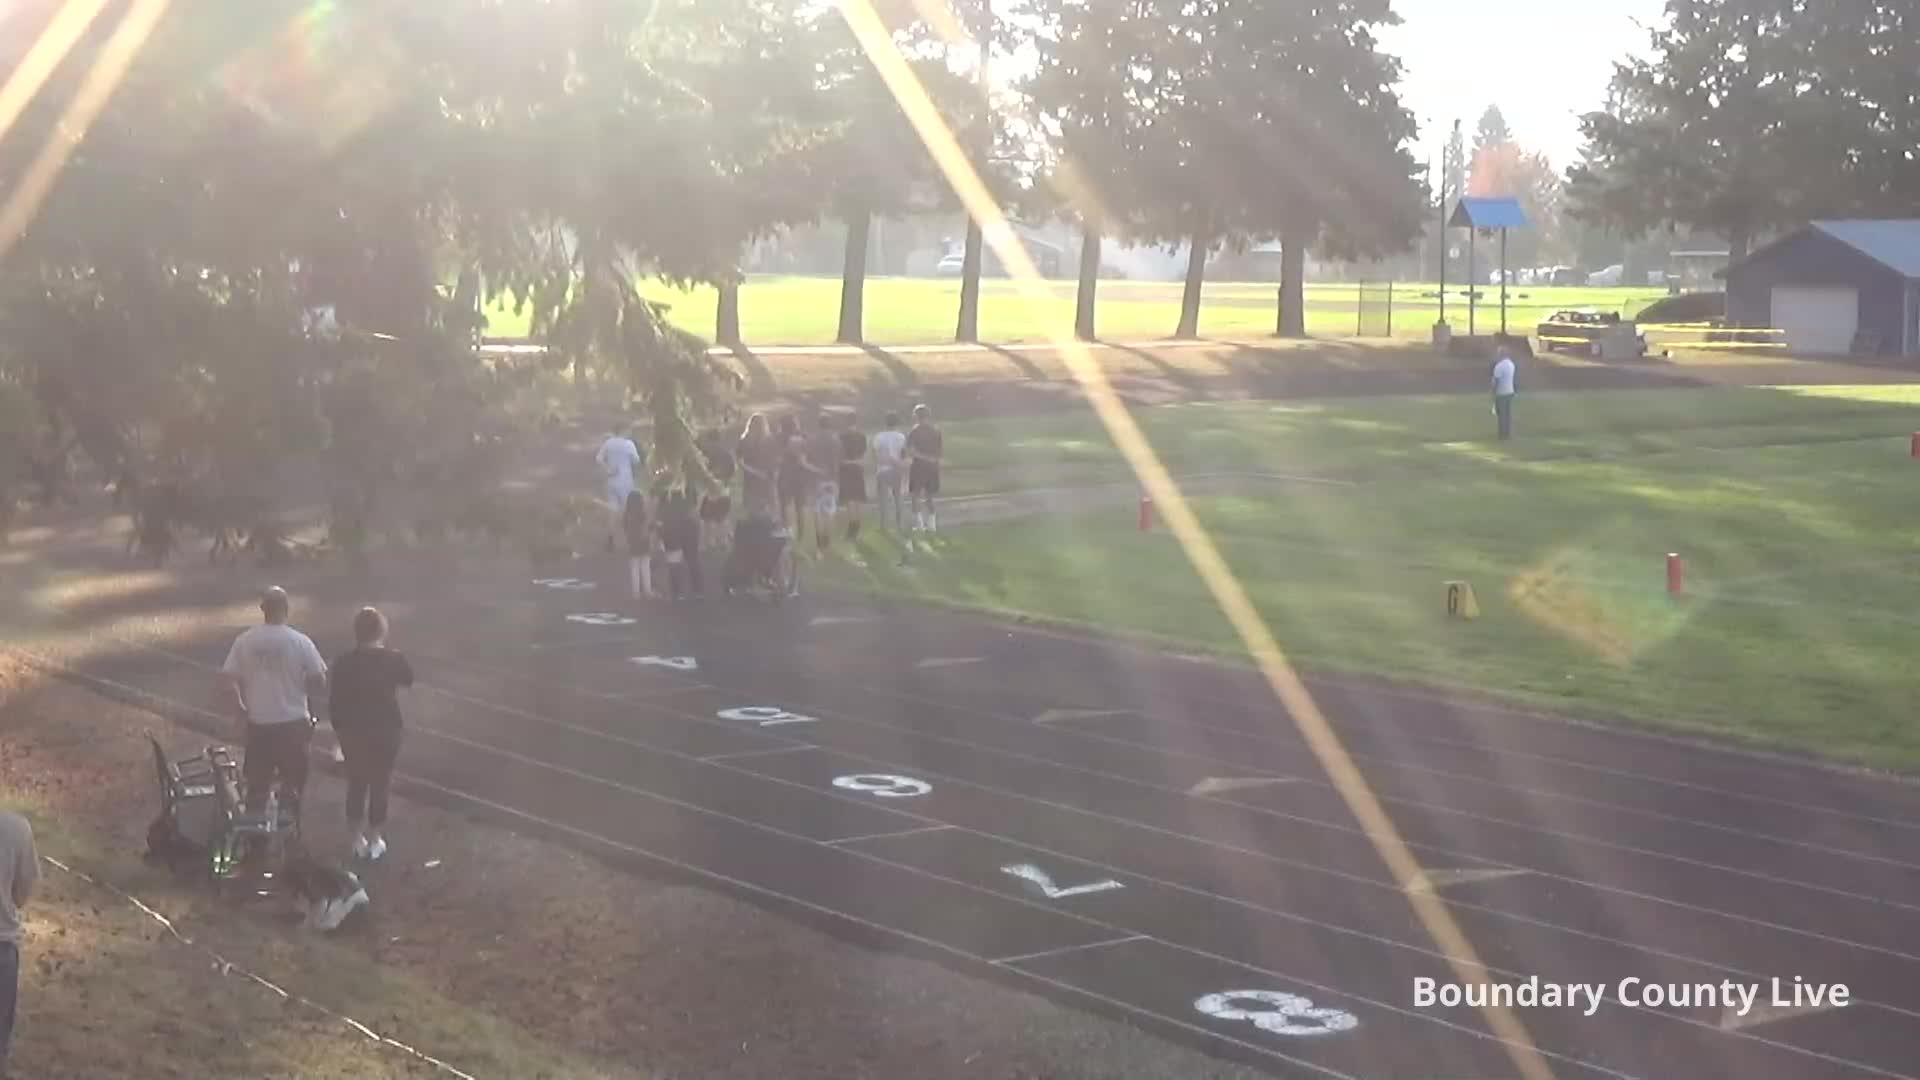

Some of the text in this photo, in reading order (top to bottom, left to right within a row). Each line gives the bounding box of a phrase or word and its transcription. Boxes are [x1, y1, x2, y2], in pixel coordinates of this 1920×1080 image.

[716, 705, 819, 727] 5
[1000, 863, 1126, 899] 7
[1193, 988, 1360, 1037] 8
